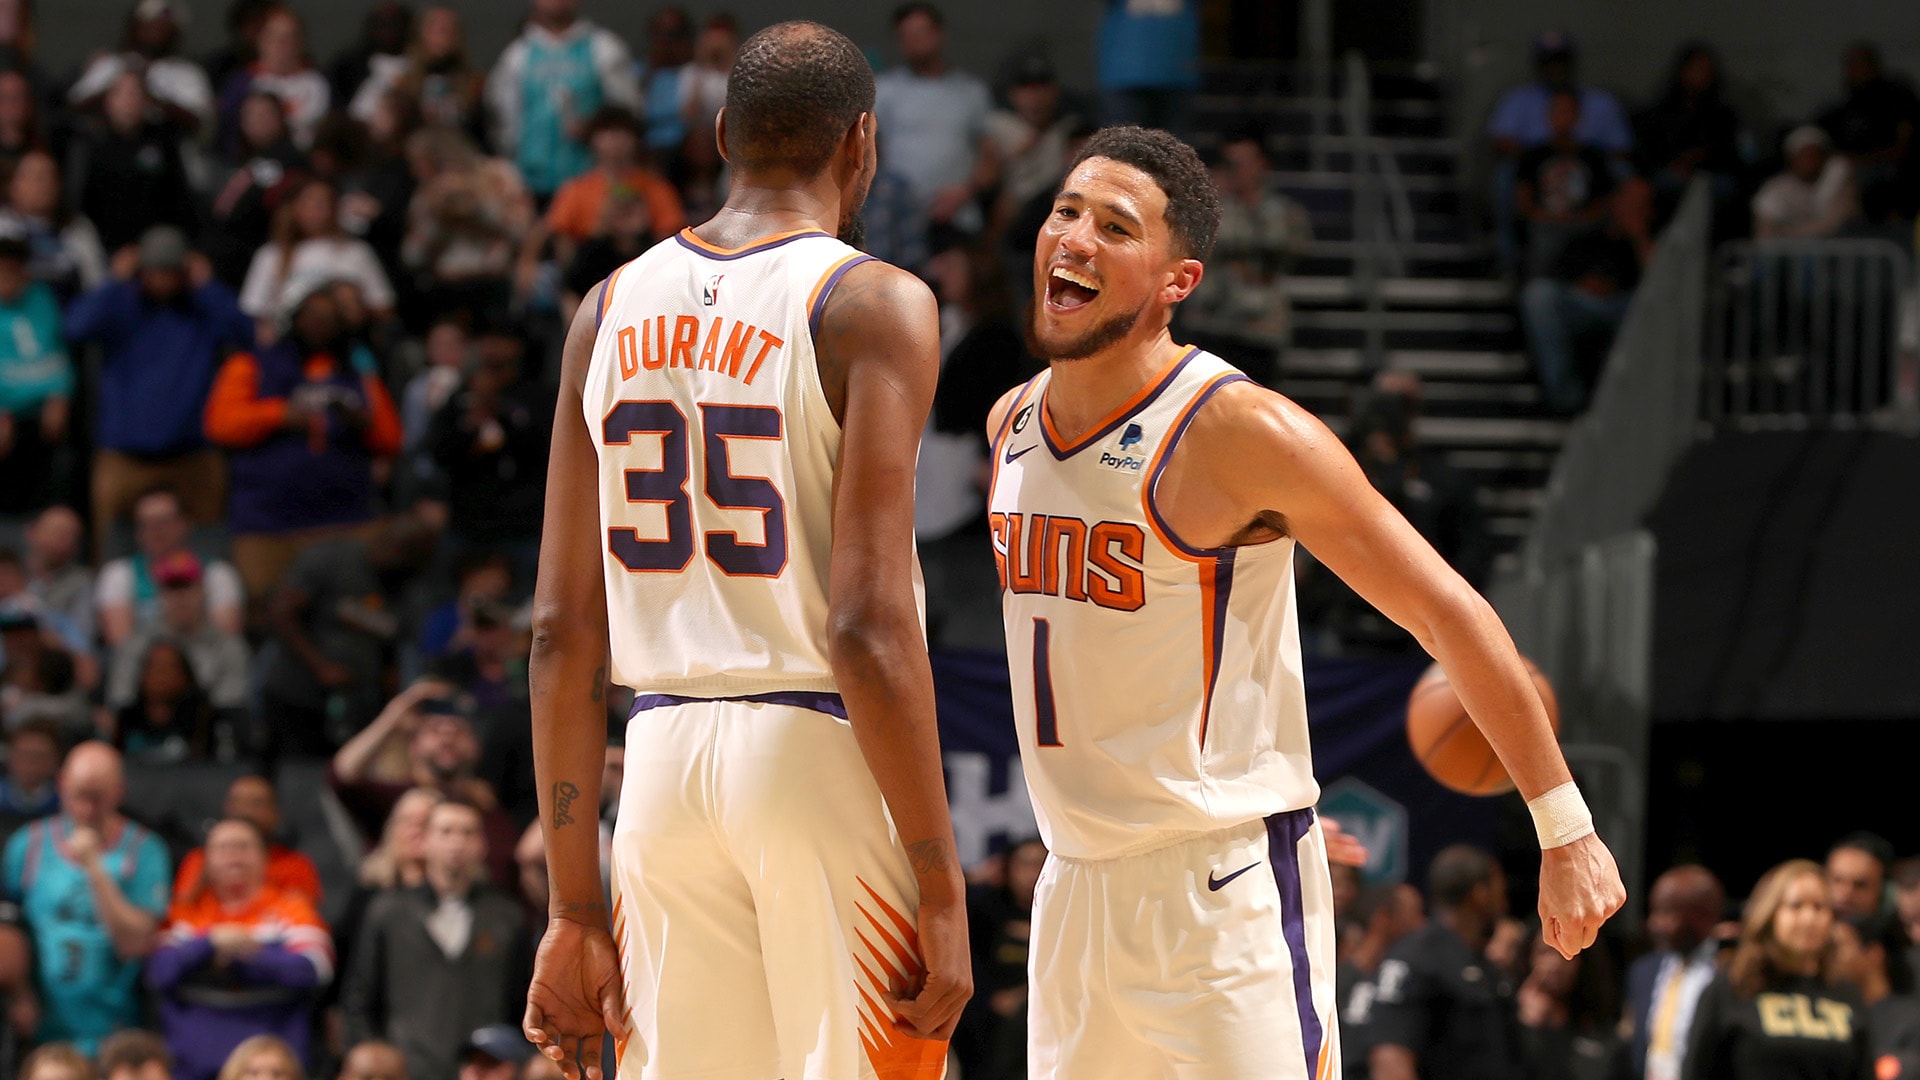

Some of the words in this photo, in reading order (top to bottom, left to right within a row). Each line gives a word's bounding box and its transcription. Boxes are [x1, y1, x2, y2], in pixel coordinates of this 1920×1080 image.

[617, 315, 785, 387] DURANT
[602, 399, 789, 579] 35
[1099, 451, 1145, 470] PayPal
[1032, 616, 1065, 748] 1
[1757, 992, 1853, 1042] CLT
